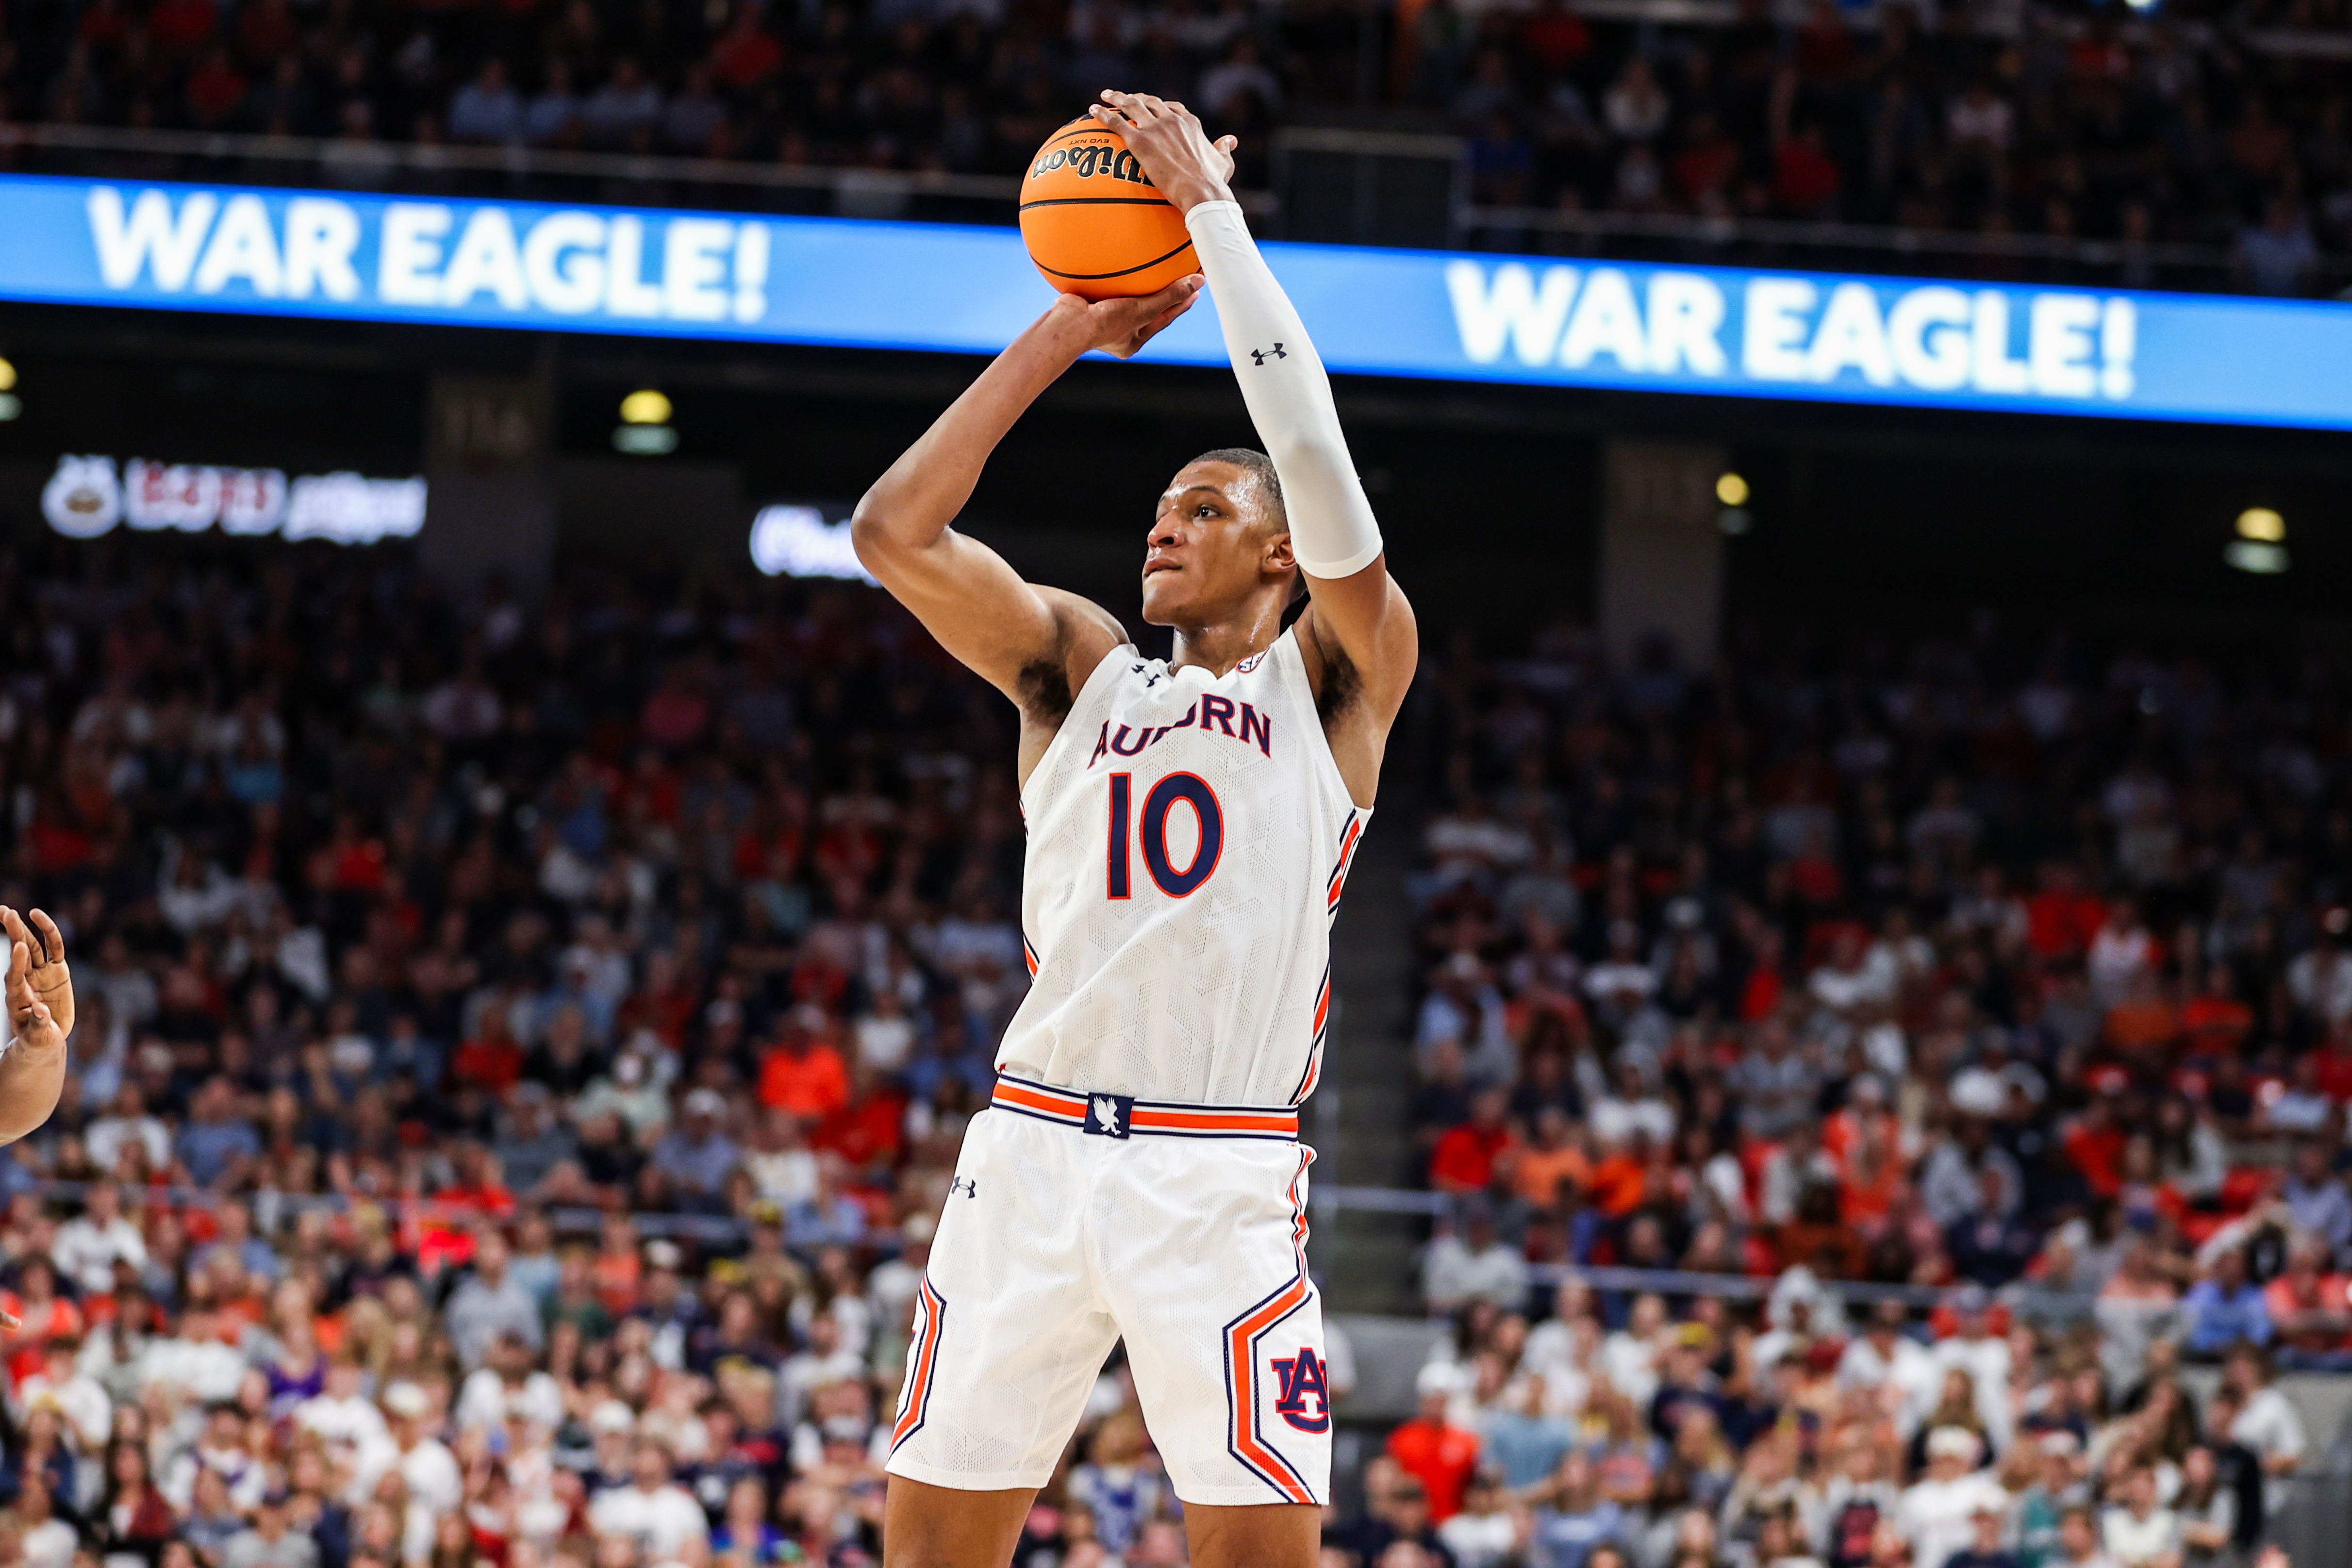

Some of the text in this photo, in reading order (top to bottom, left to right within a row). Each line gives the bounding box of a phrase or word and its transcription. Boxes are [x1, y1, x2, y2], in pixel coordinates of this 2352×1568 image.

[1032, 145, 1156, 188] Wilson
[88, 190, 770, 323] WAR EAGLE!
[1445, 262, 2136, 399] WAR EAGLE!
[1107, 771, 1224, 900] 10
